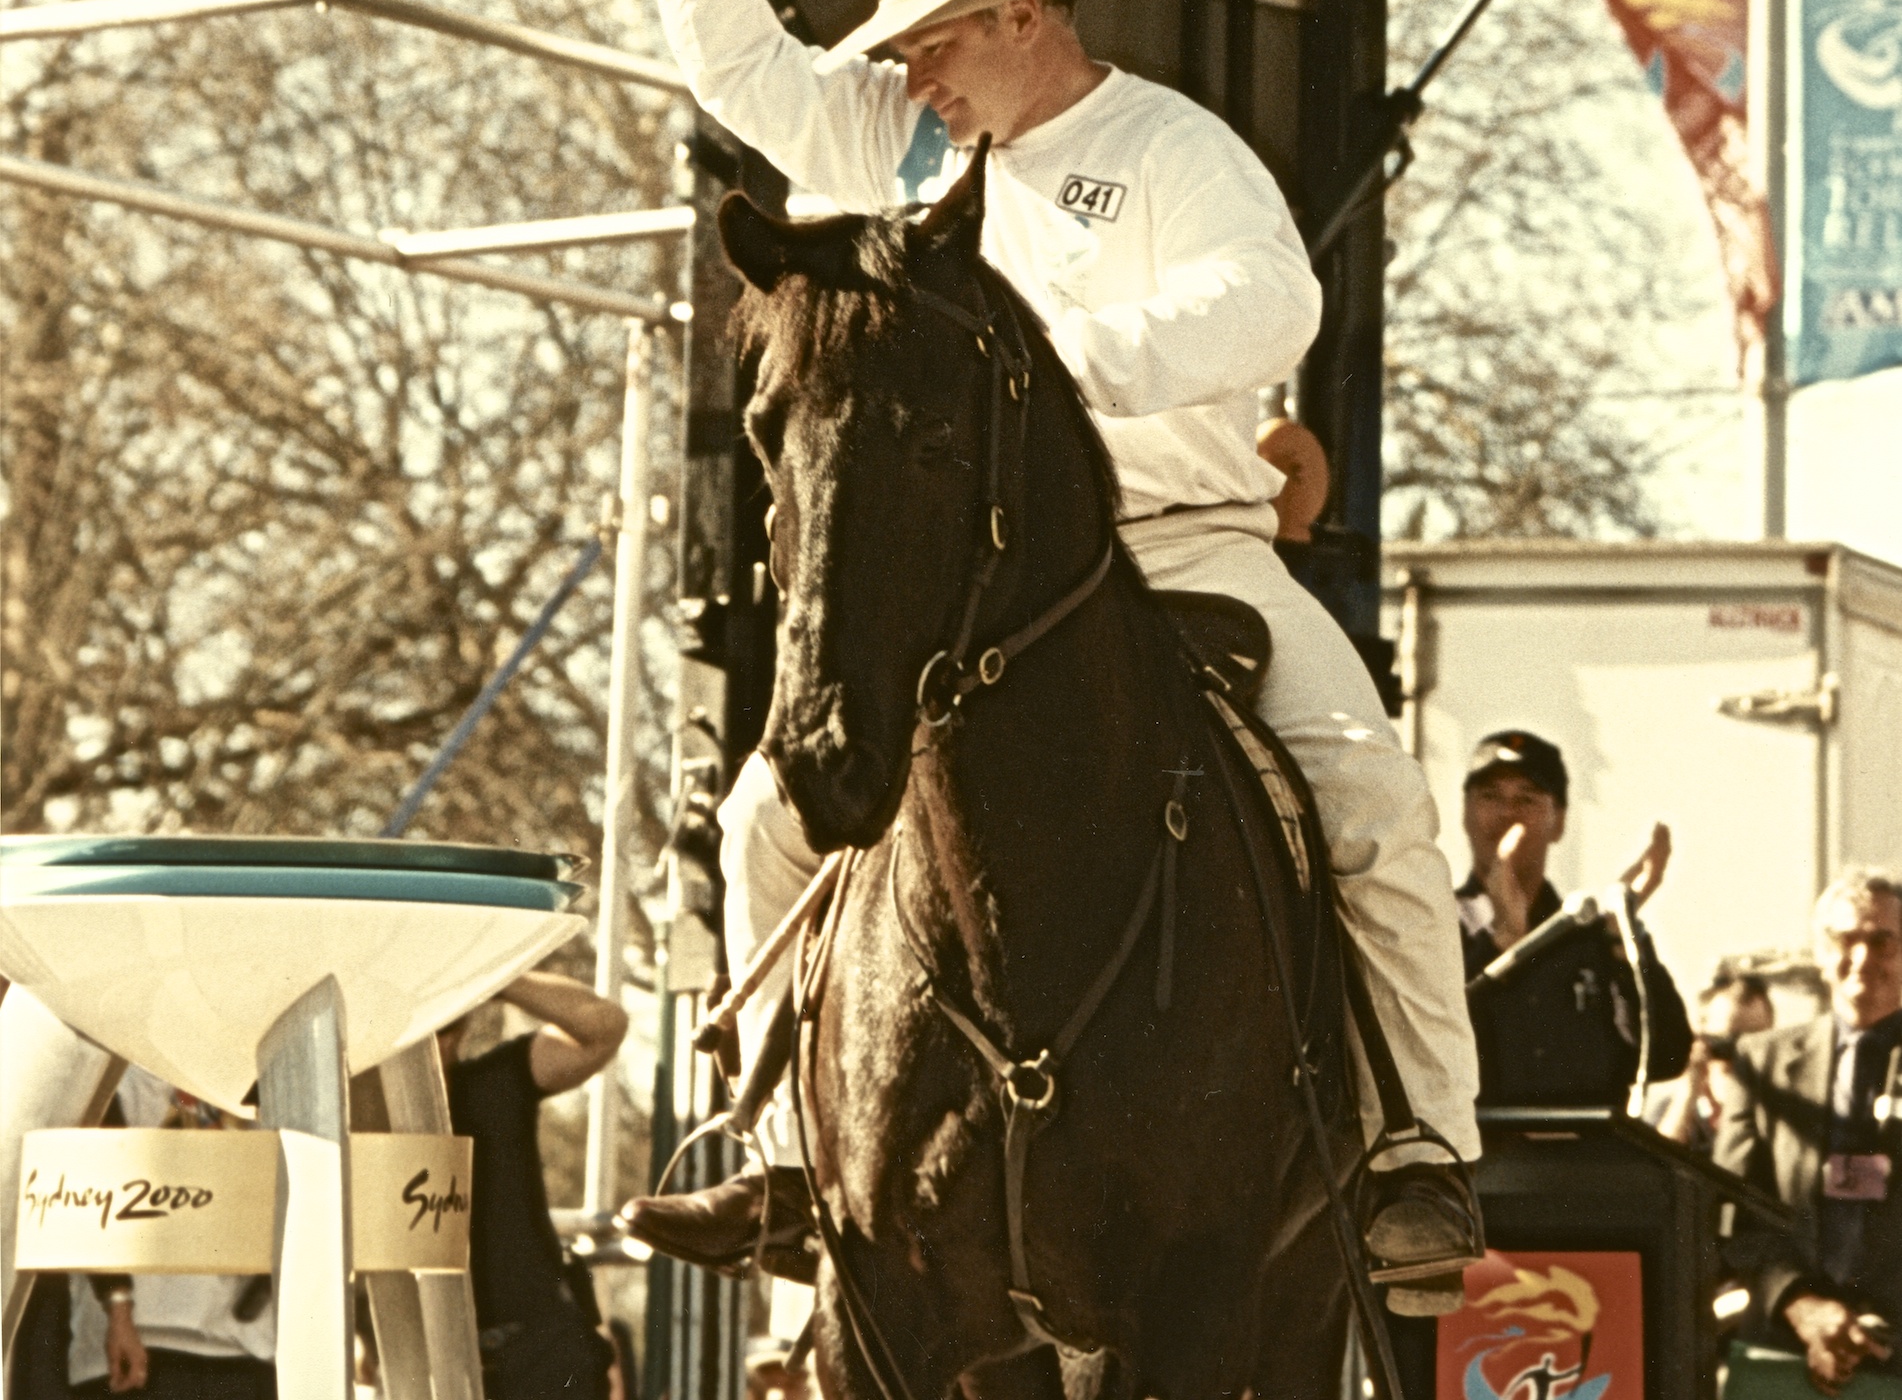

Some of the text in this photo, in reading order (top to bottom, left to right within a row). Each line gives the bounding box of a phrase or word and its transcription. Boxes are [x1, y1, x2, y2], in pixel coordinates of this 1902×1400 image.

[1061, 180, 1114, 214] 041
[25, 1169, 213, 1230] Sydney 2000
